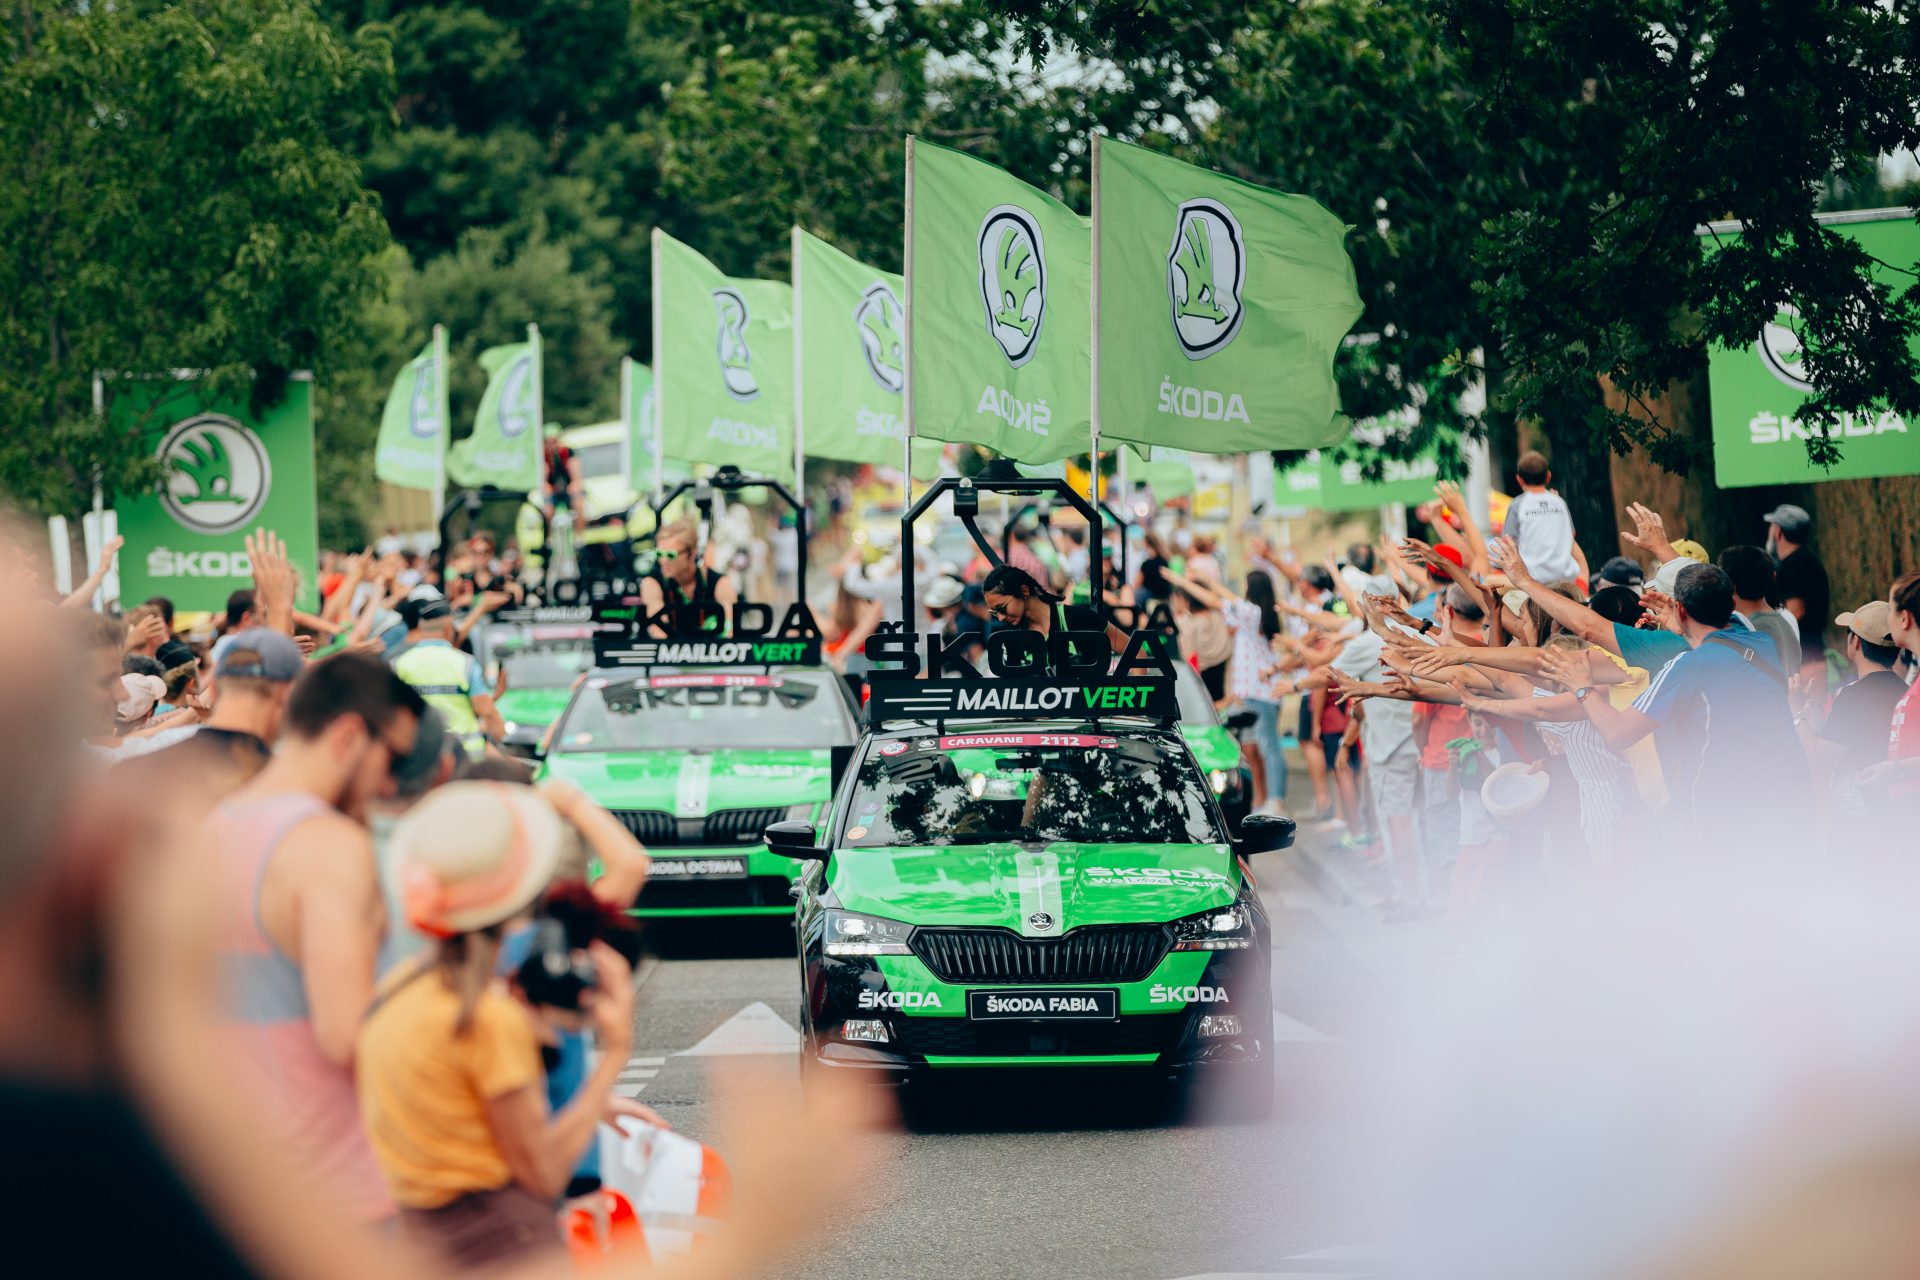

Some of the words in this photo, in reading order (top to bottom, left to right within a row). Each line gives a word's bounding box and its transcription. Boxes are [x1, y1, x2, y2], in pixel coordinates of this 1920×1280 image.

[1157, 375, 1251, 424] ŠKODA
[147, 547, 255, 577] ŠKOD
[657, 643, 752, 663] MAILLOT
[752, 643, 808, 663] VERT
[865, 620, 1177, 679] ŠKODA
[957, 687, 1080, 710] MAILLOT
[1083, 686, 1155, 709] VERT
[947, 736, 1024, 747] CARAVANE
[1040, 736, 1081, 747] 2112
[687, 859, 744, 875] OCTAVIA
[858, 989, 942, 1009] ŠKODA
[986, 995, 1046, 1013] ŠKODA
[1049, 998, 1099, 1013] FABIA
[1149, 984, 1230, 1004] ŠKODA
